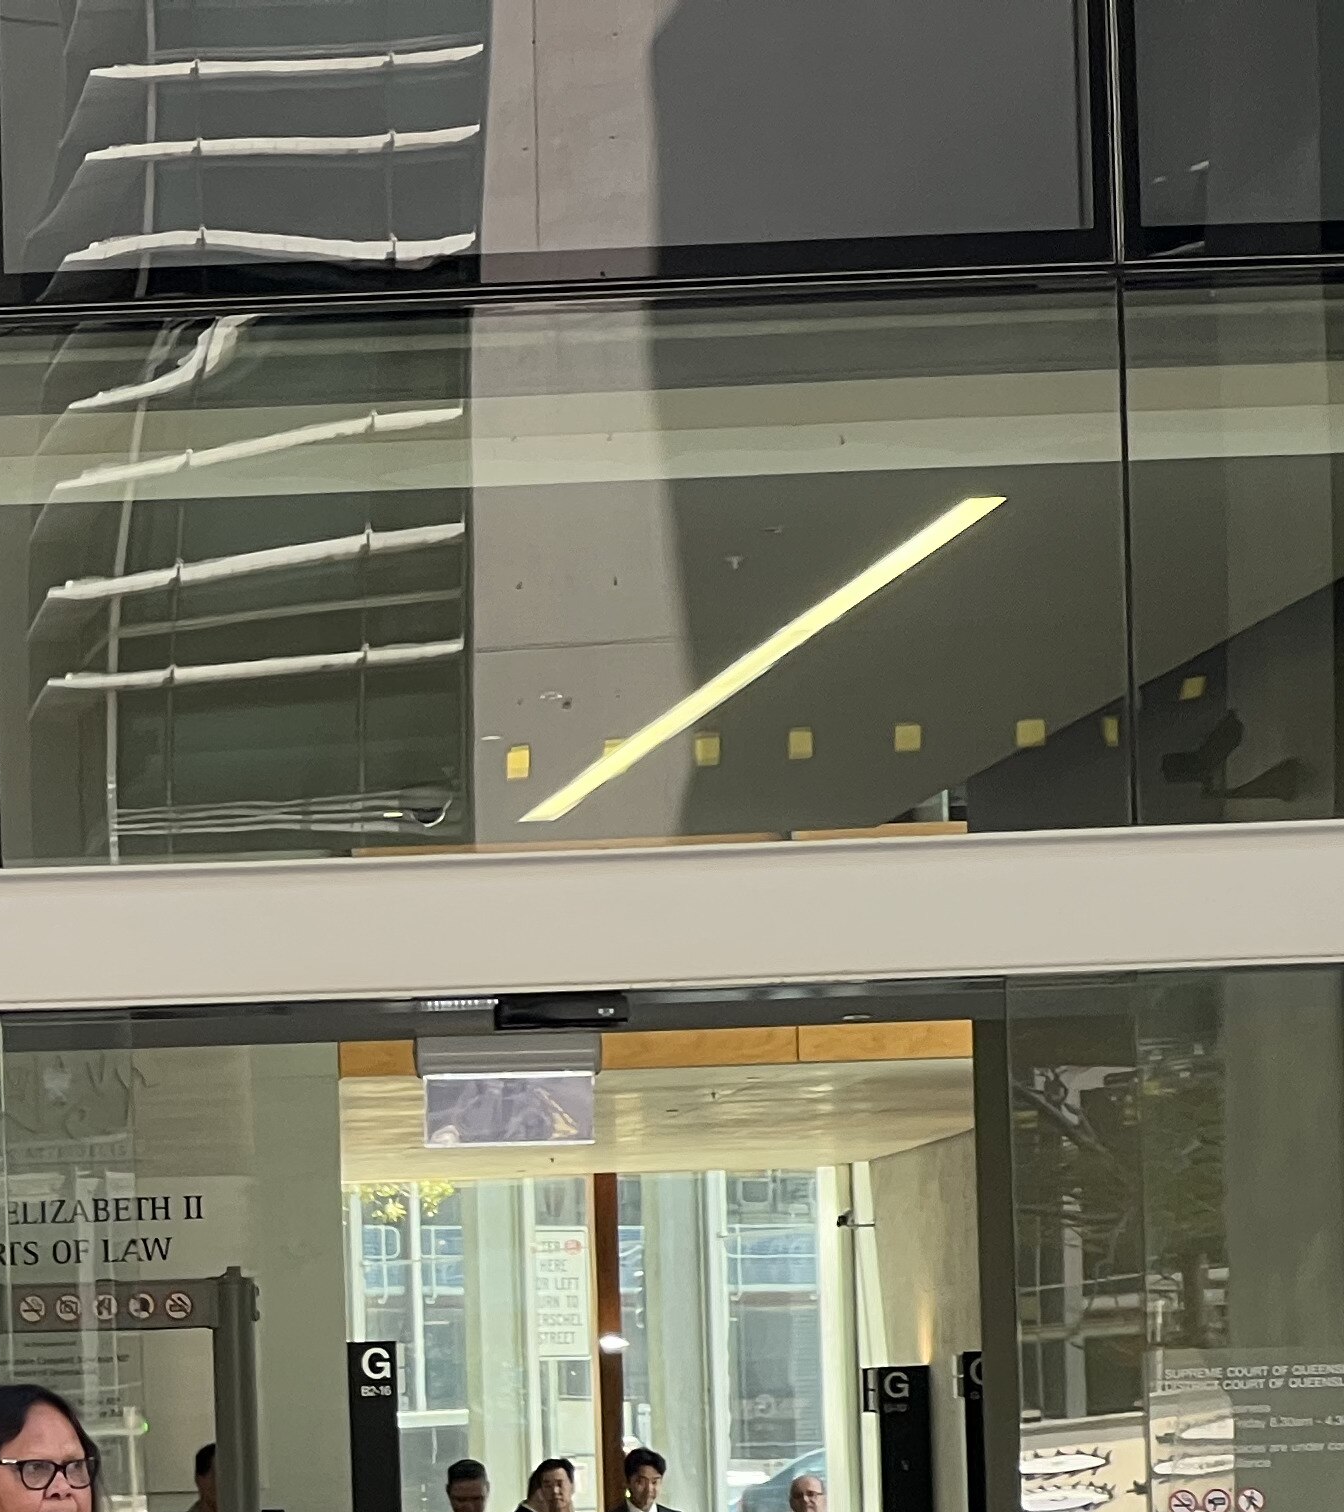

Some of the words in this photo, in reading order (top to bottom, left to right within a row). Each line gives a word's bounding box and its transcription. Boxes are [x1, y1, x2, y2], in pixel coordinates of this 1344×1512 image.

[7, 1196, 171, 1225] ELIZABETH
[183, 1195, 204, 1220] II
[51, 1238, 91, 1265] OF
[101, 1236, 173, 1263] LAW
[362, 1347, 391, 1380] G
[1164, 1367, 1223, 1379] SUPREME
[1226, 1366, 1270, 1377] COURT
[1272, 1365, 1289, 1376] OF
[884, 1371, 910, 1398] G
[1222, 1379, 1266, 1390] COURT
[1268, 1378, 1285, 1388] OF
